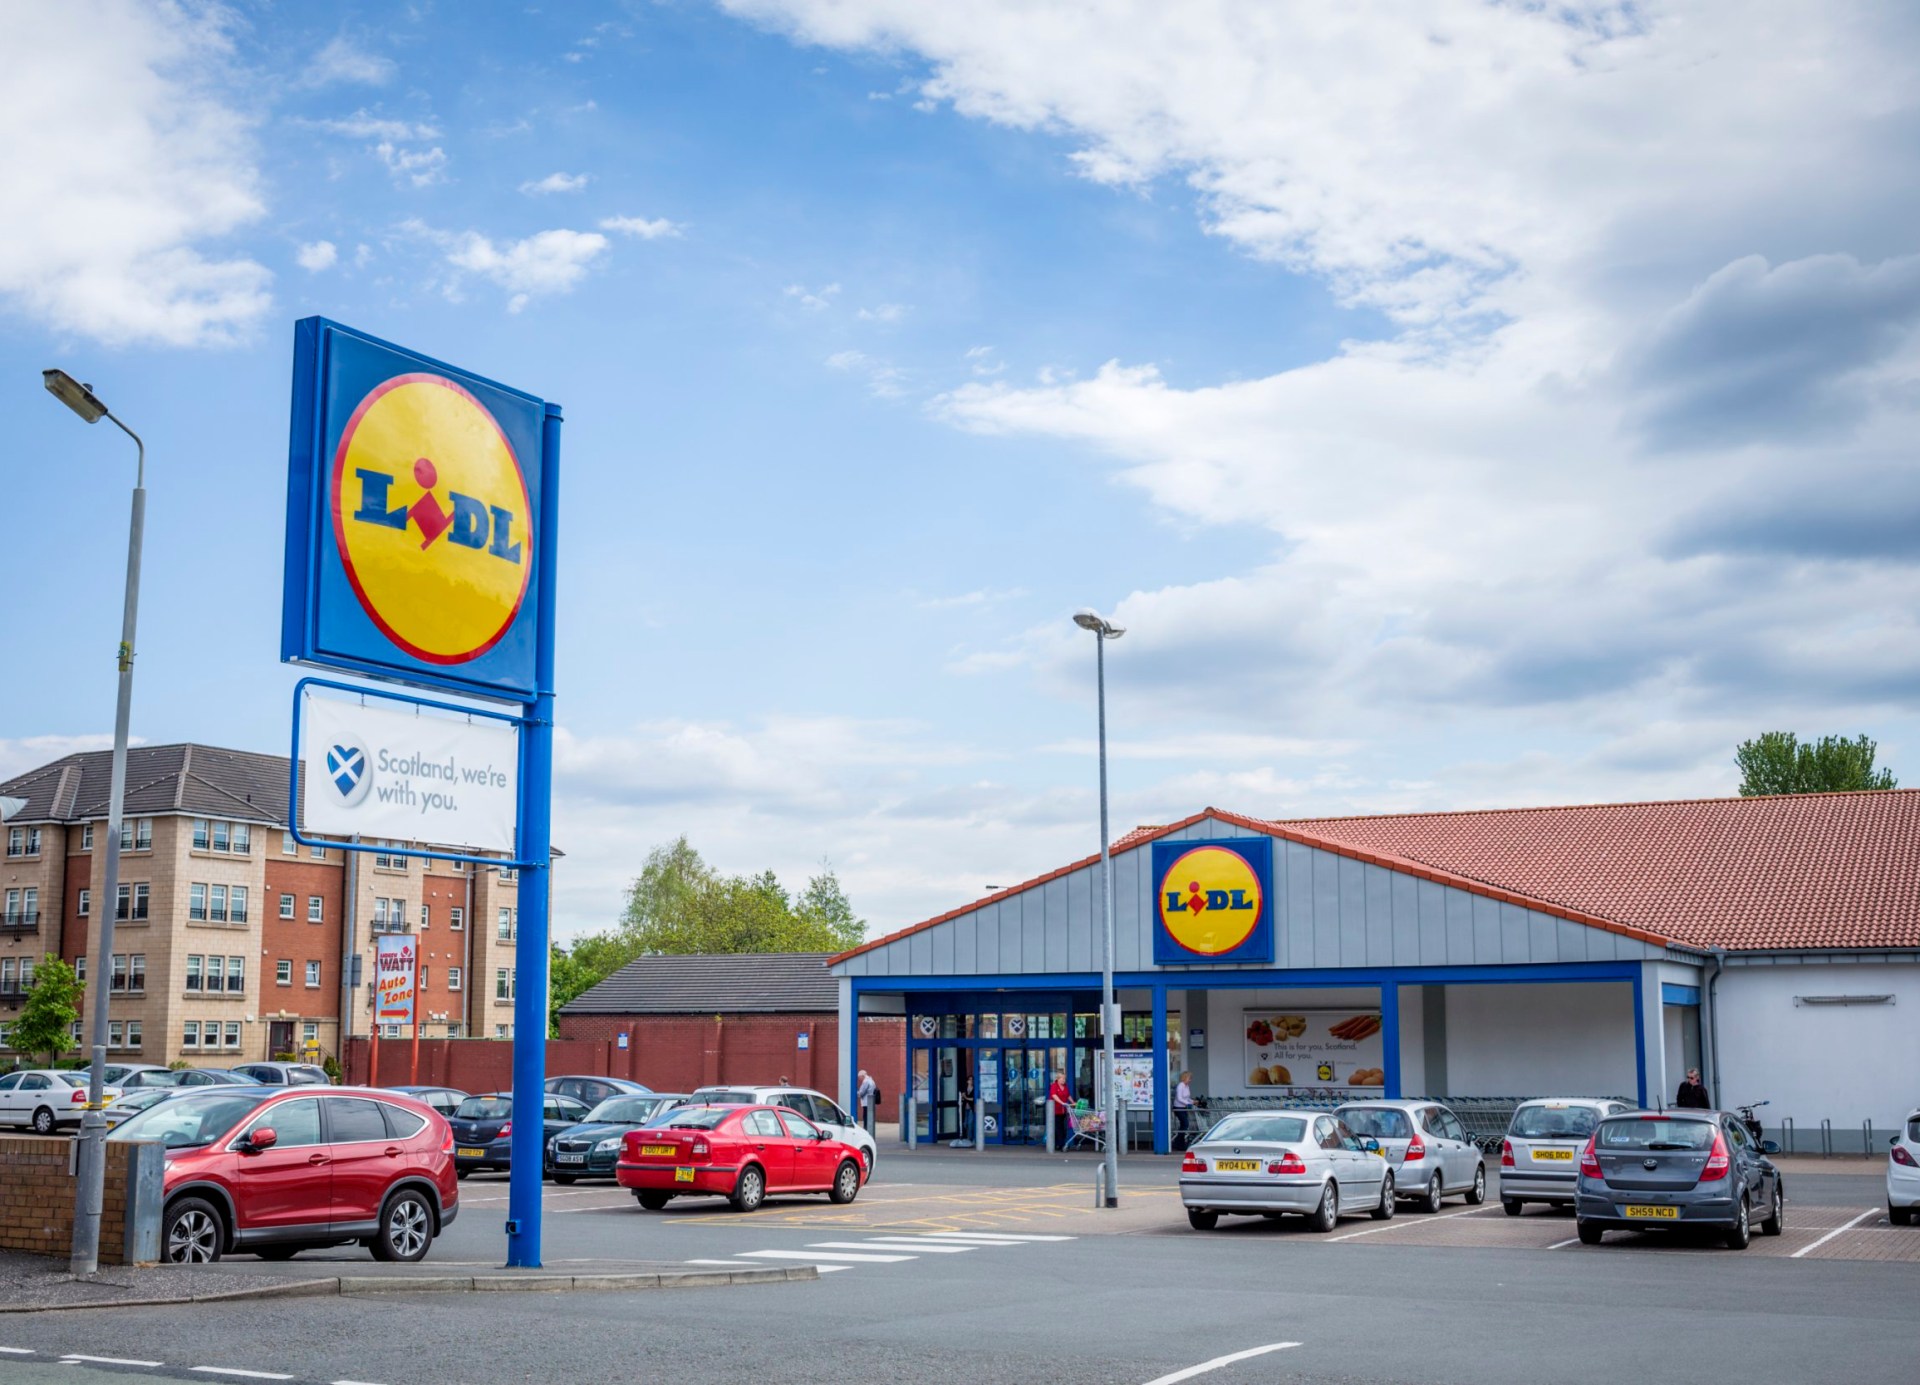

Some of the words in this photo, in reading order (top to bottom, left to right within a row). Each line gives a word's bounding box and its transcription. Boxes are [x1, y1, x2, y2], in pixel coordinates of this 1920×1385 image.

[377, 747, 459, 786] Scotland,
[461, 763, 507, 789] we're
[377, 780, 416, 806] with
[421, 792, 458, 814] you.
[380, 958, 414, 971] WATT
[379, 976, 406, 992] Auto
[384, 988, 413, 1006] Zone
[1296, 1042, 1306, 1050] for
[1274, 1051, 1284, 1059] All
[1285, 1051, 1296, 1059] for
[1297, 1053, 1313, 1061] you.
[1218, 1161, 1239, 1170] RY04
[1630, 1207, 1654, 1217] SH59
